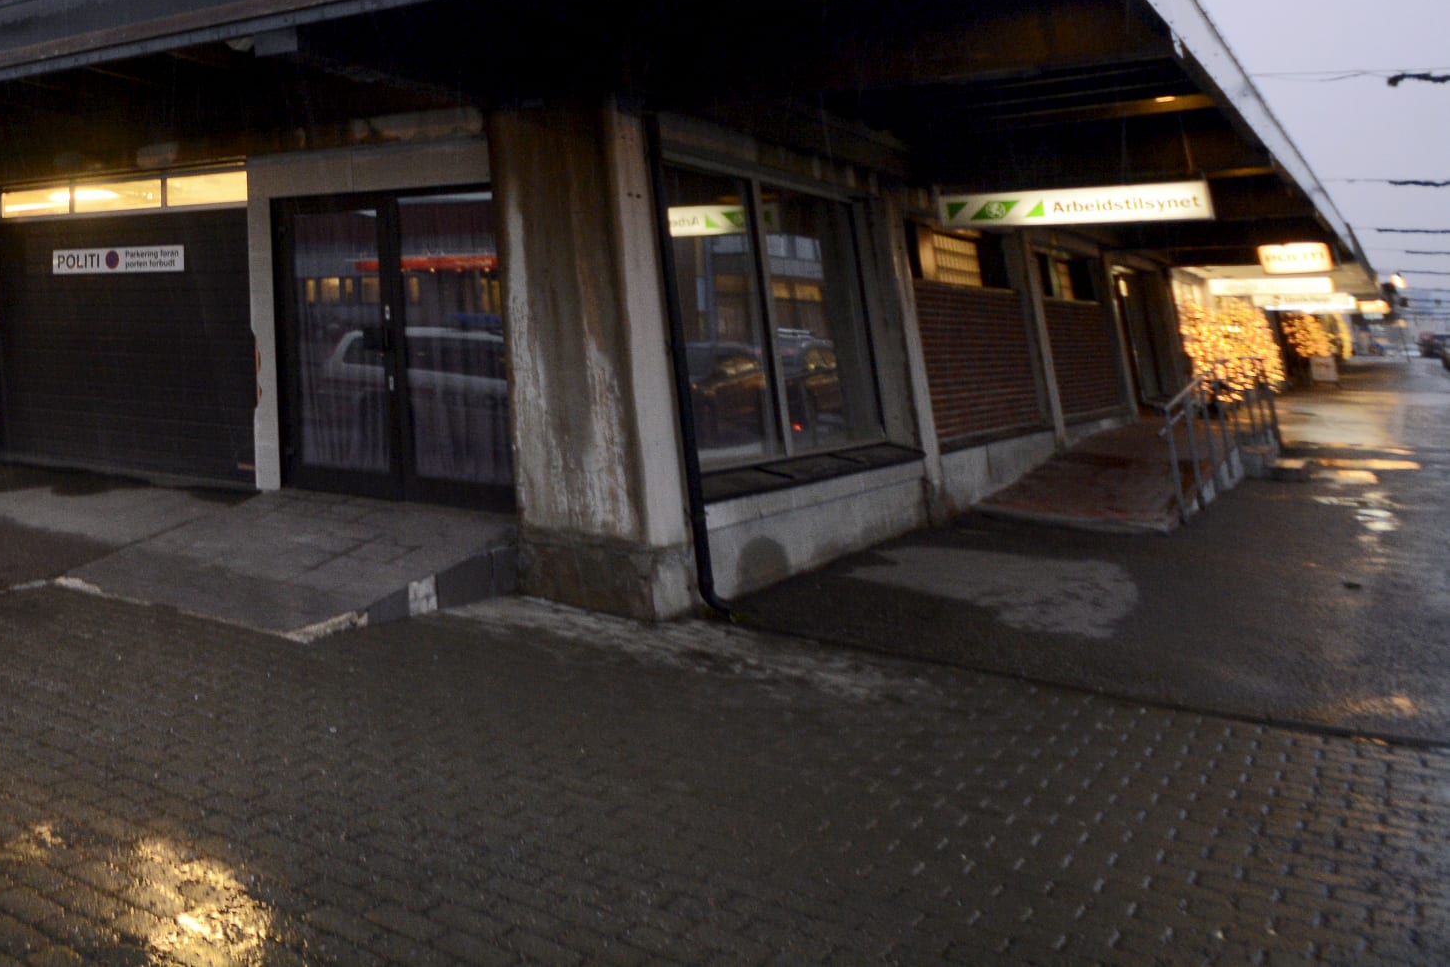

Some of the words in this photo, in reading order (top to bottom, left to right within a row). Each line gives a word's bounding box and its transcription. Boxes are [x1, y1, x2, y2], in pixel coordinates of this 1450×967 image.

[1052, 193, 1202, 214] Arbeidstilsynet
[57, 253, 100, 269] POLITI
[125, 250, 158, 260] Parkering
[160, 249, 179, 258] foran
[125, 260, 148, 269] porten
[149, 257, 176, 267] forbudt
